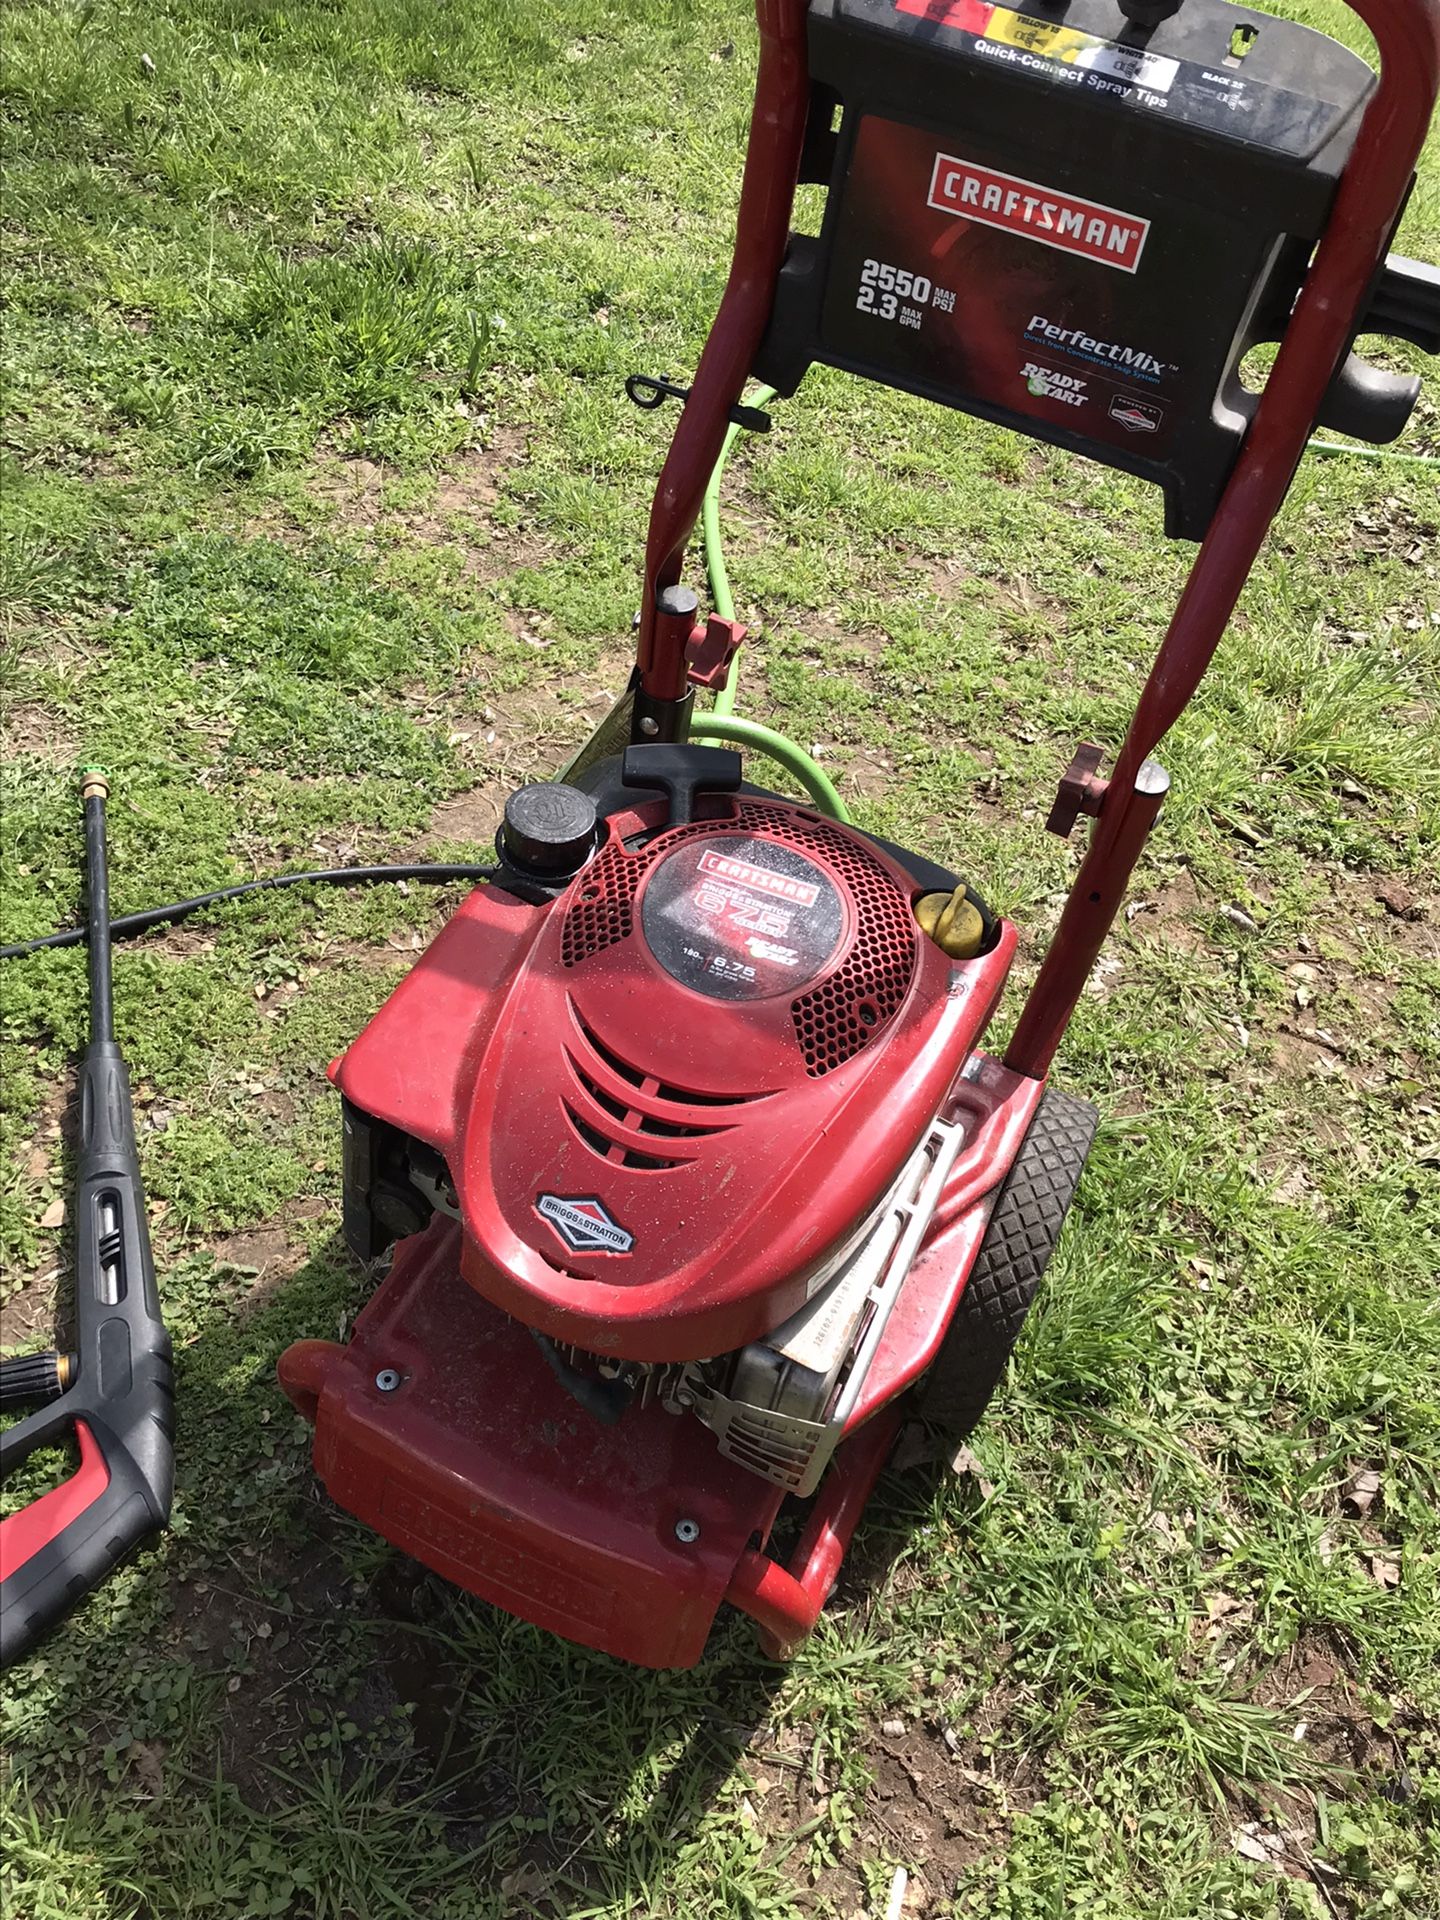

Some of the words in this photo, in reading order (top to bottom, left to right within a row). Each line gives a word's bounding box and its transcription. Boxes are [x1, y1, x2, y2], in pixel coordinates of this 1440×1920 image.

[1016, 15, 1051, 31] YELLOW
[974, 39, 1084, 82] Quick-Connect
[1087, 74, 1132, 98] Spray
[1136, 89, 1169, 108] Tips
[1201, 71, 1231, 86] BLACK
[943, 170, 1131, 254] CRAFTSMAN
[861, 258, 931, 303] 2550
[934, 287, 957, 303] MAX
[856, 285, 898, 320] 2.3
[901, 306, 922, 320] MAX
[932, 296, 955, 313] PSI
[899, 315, 921, 330] GPM
[1023, 331, 1046, 345] Direct
[1048, 340, 1065, 352] from
[1066, 346, 1112, 368] Concentrate
[1132, 369, 1160, 384] System
[1027, 315, 1166, 375] PerfectMix
[1020, 362, 1087, 392] READY
[1030, 378, 1089, 407] START
[707, 856, 809, 899] CRAFTSMAN
[694, 890, 790, 935] 675
[713, 956, 757, 977] 6.75
